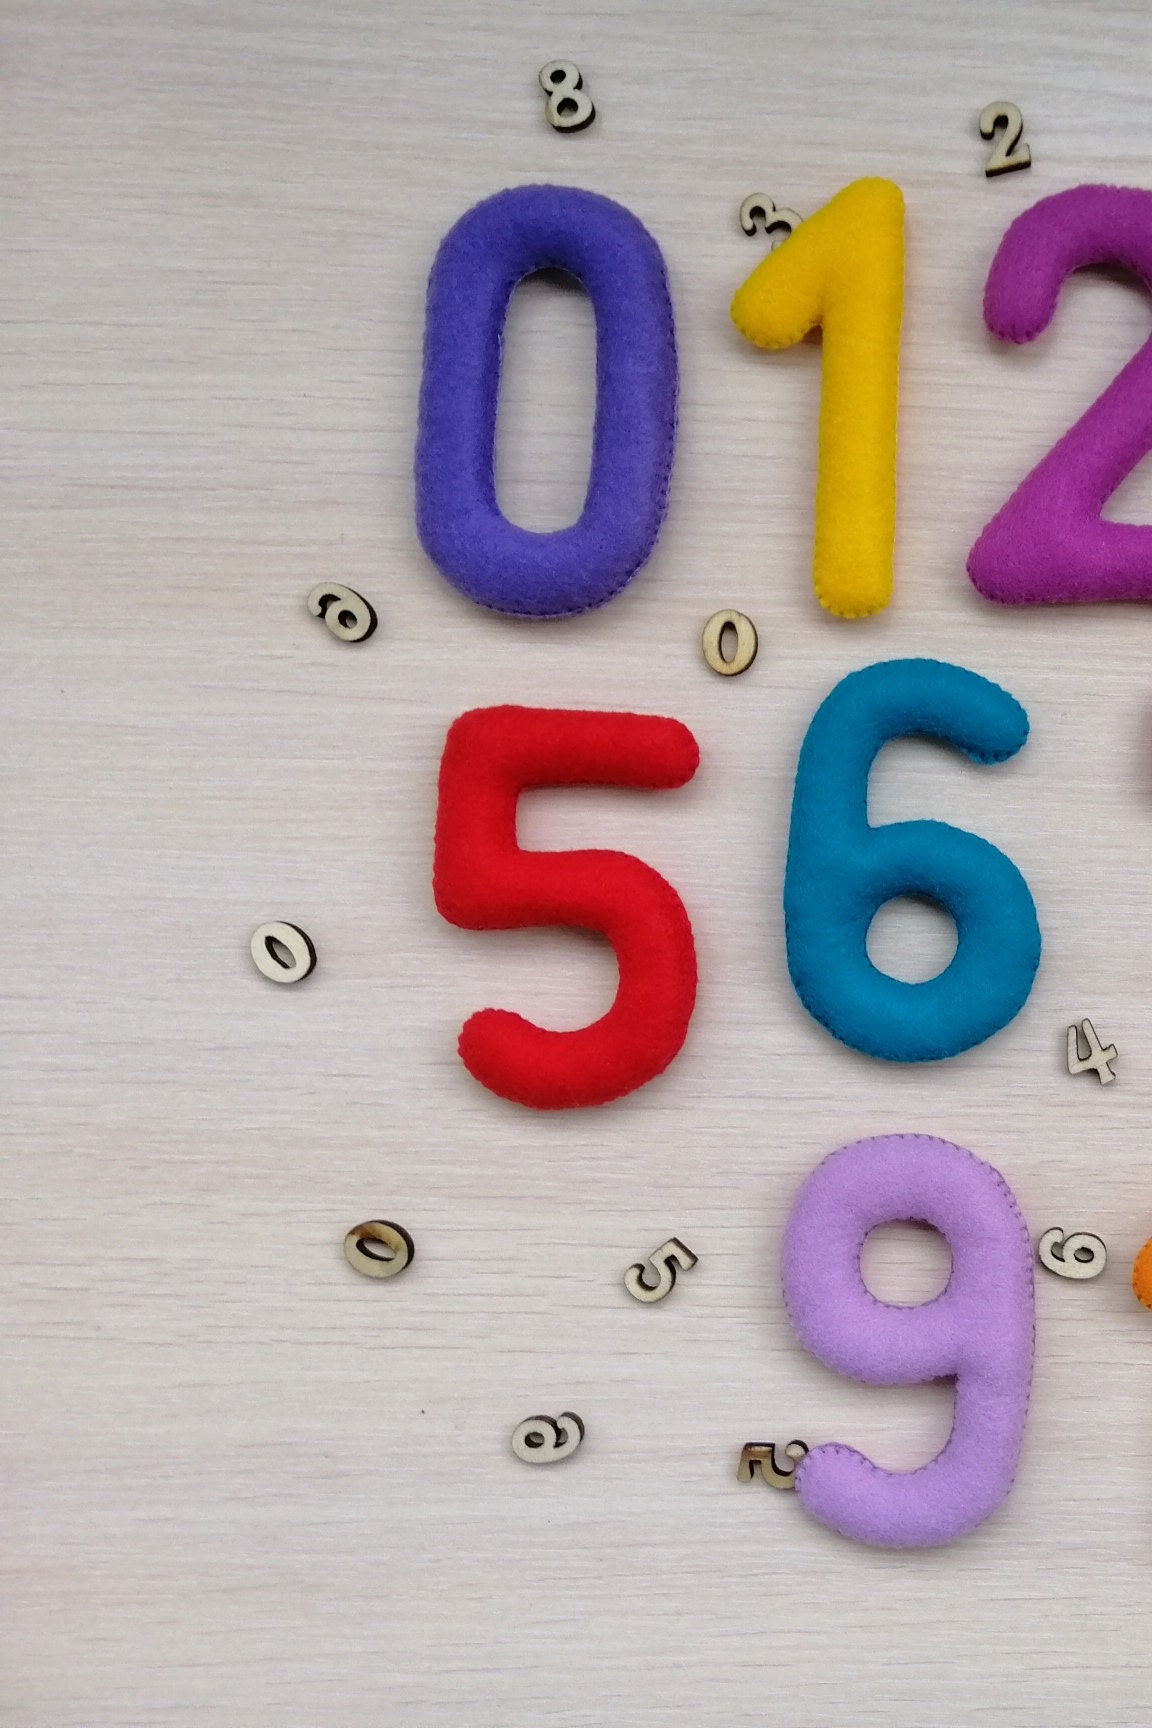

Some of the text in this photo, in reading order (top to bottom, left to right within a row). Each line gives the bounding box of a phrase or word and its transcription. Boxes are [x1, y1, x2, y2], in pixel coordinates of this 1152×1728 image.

[539, 59, 595, 133] 8
[979, 101, 1032, 178] 2
[415, 184, 680, 619] 0
[729, 176, 909, 621] 1
[701, 609, 759, 677] 0
[434, 704, 700, 1109] 5
[784, 658, 1042, 1063] 6
[250, 921, 318, 984] 0
[1066, 1018, 1119, 1085] 4
[343, 1219, 416, 1279] 0
[624, 1236, 699, 1304] 5
[781, 1134, 1037, 1548] 9
